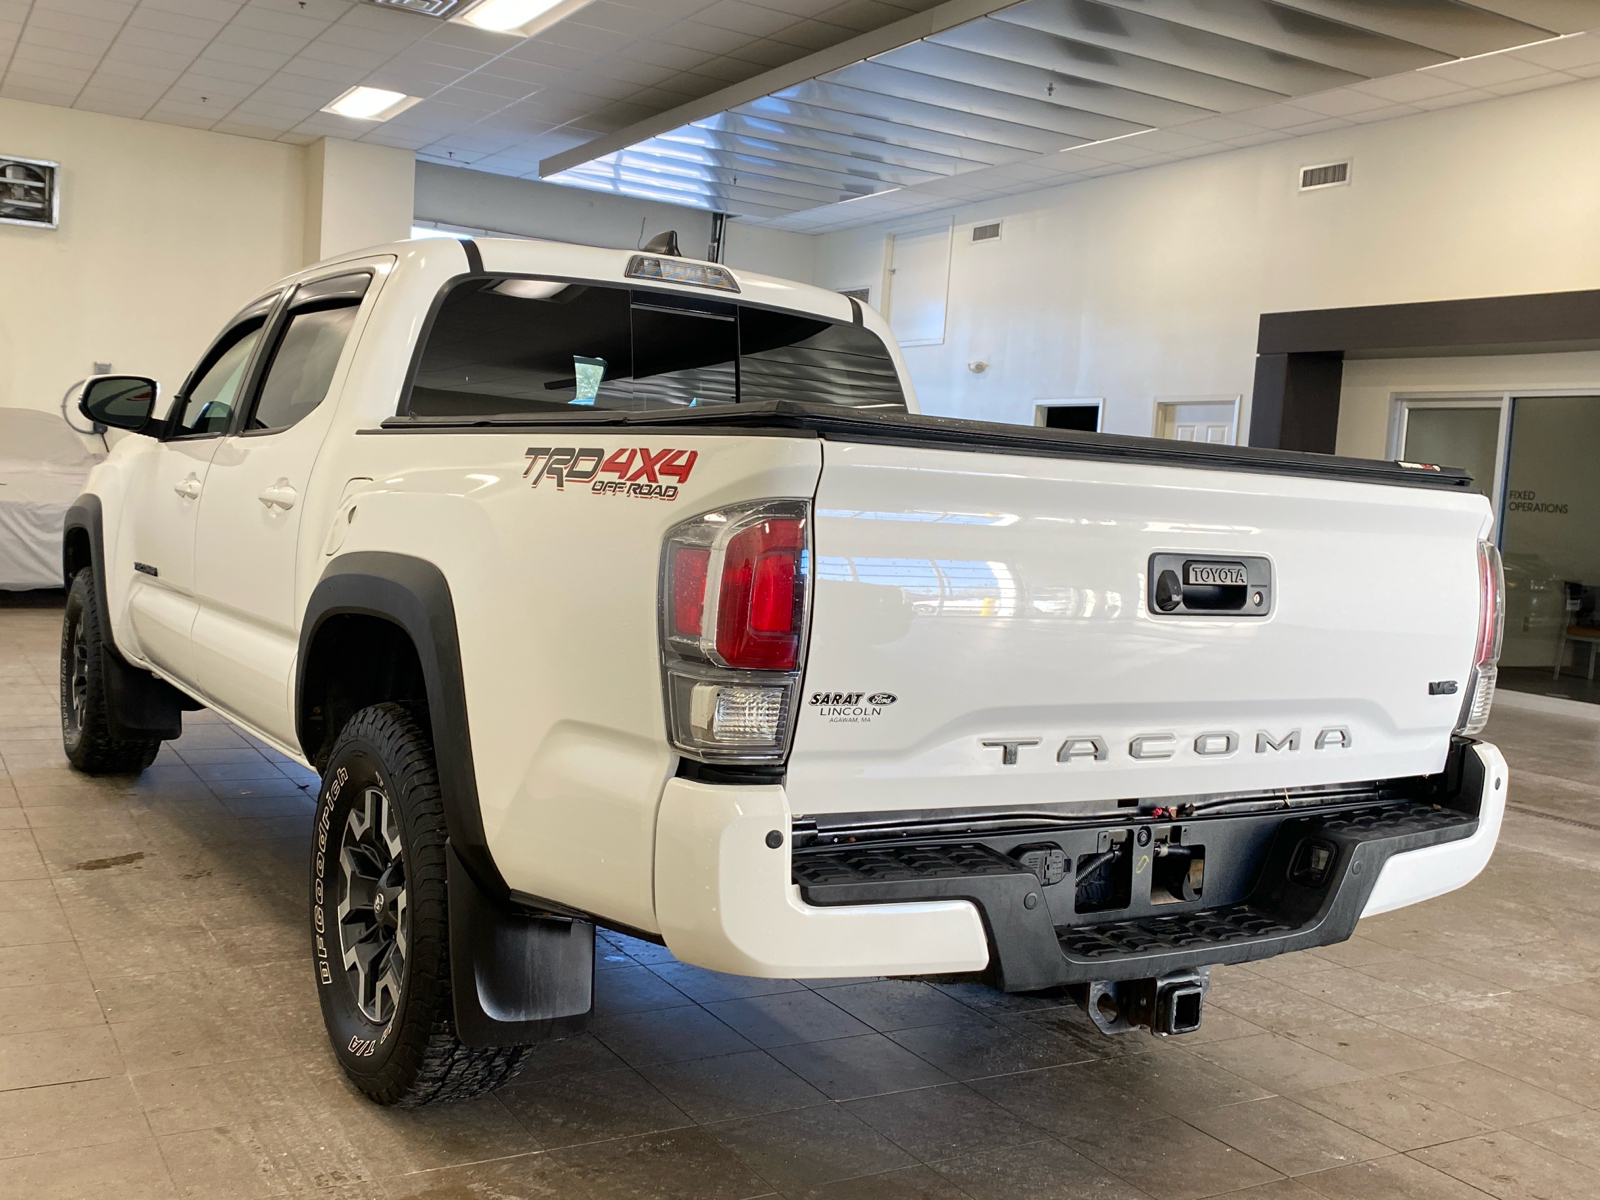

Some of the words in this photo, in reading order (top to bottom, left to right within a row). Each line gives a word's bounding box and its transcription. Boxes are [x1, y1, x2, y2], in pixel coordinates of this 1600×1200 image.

[522, 447, 605, 491] TRD
[600, 448, 698, 484] 4X4
[591, 480, 627, 496] OFF
[626, 482, 679, 501] ROAD
[1509, 490, 1536, 500] FIXED
[1508, 501, 1569, 514] OPERATIONS
[1192, 566, 1246, 583] TOYOTA
[1429, 680, 1458, 695] V6
[809, 692, 865, 706] SARAT
[870, 693, 895, 705] Ford
[820, 707, 882, 716] LINCOLN
[980, 725, 1353, 766] TACOMA
[314, 766, 349, 985] BFGoodrich
[348, 1035, 376, 1056] T/A
